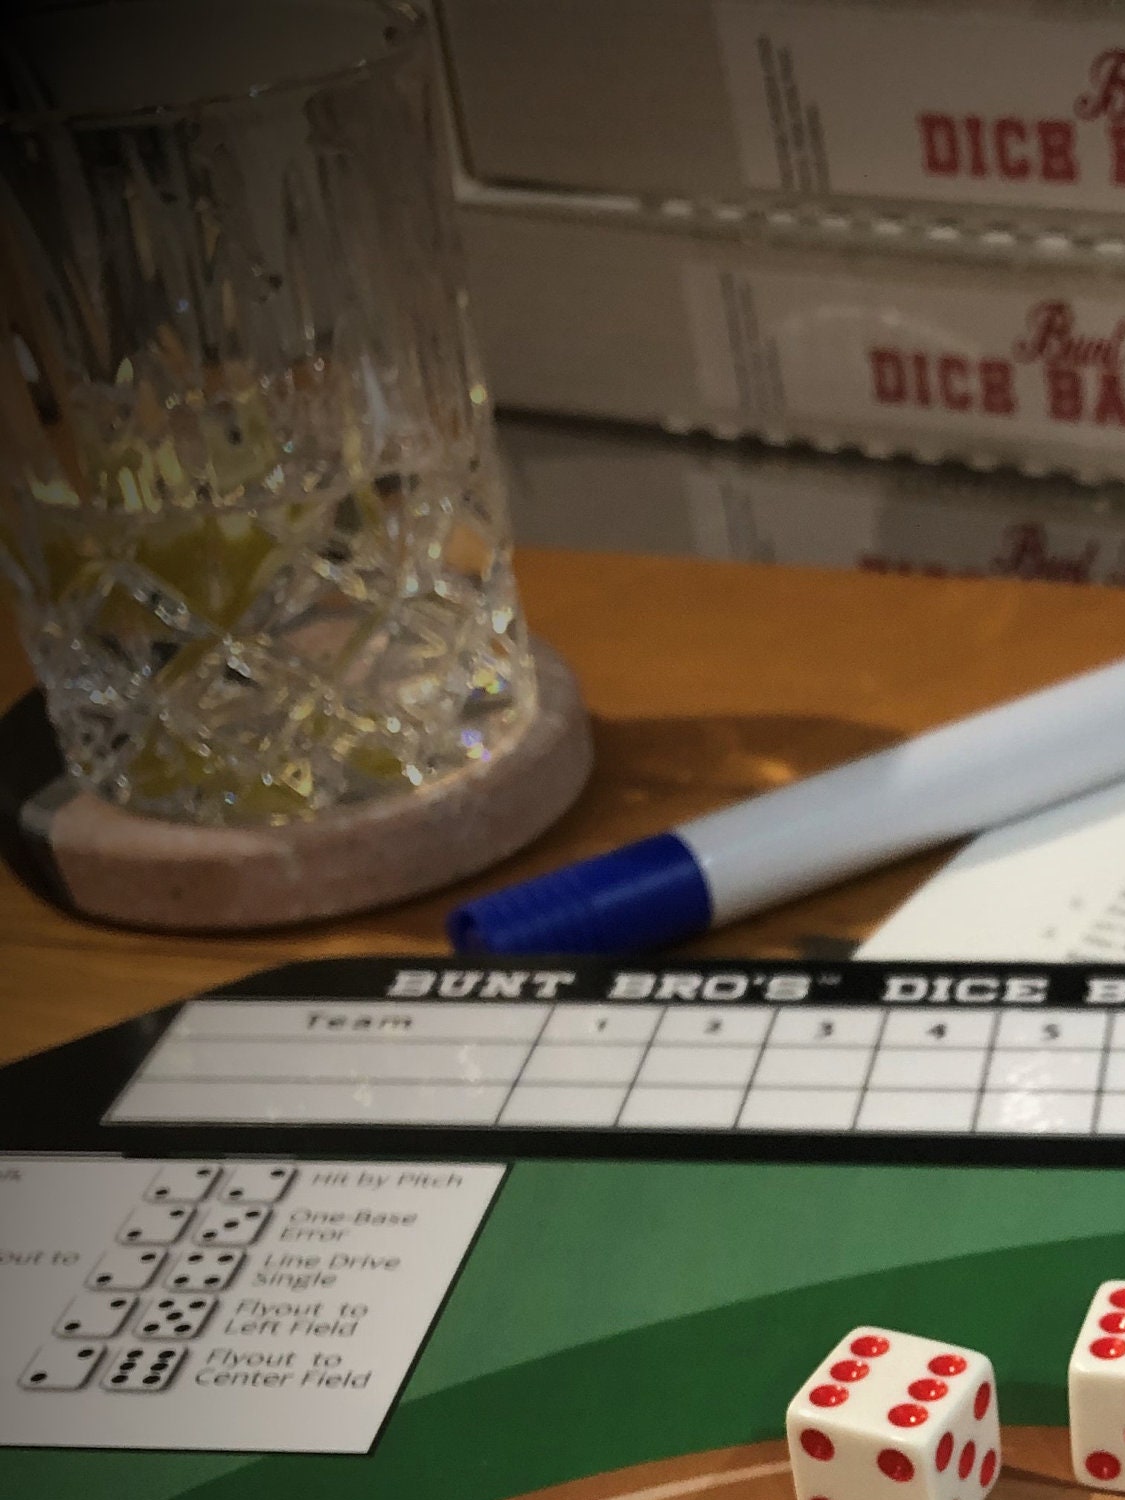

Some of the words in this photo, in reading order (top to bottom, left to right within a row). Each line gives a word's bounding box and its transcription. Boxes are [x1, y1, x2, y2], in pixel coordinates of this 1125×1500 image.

[916, 112, 1079, 187] DICE
[867, 346, 1019, 416] DICE
[386, 969, 576, 999] BUNT
[880, 974, 1050, 1003] DICE
[305, 1009, 413, 1032] Team
[596, 1017, 608, 1033] 1
[705, 1017, 724, 1035] 2
[818, 1018, 836, 1038] 3
[926, 1022, 948, 1041] 4
[1042, 1022, 1062, 1042] 5
[311, 1171, 348, 1187] Hit
[356, 1169, 390, 1190] by
[397, 1170, 464, 1188] Pitch
[280, 1226, 346, 1242] Error
[51, 1251, 80, 1267] to
[263, 1252, 322, 1269] Line
[328, 1253, 403, 1271] Drive
[251, 1270, 338, 1291] Single
[235, 1299, 324, 1317] Flyout
[338, 1302, 370, 1318] to
[223, 1318, 281, 1336] Left
[289, 1320, 359, 1337] Field
[206, 1348, 297, 1369] Flyout
[312, 1351, 343, 1368] to
[194, 1366, 296, 1388] Center
[300, 1368, 373, 1389] Field
